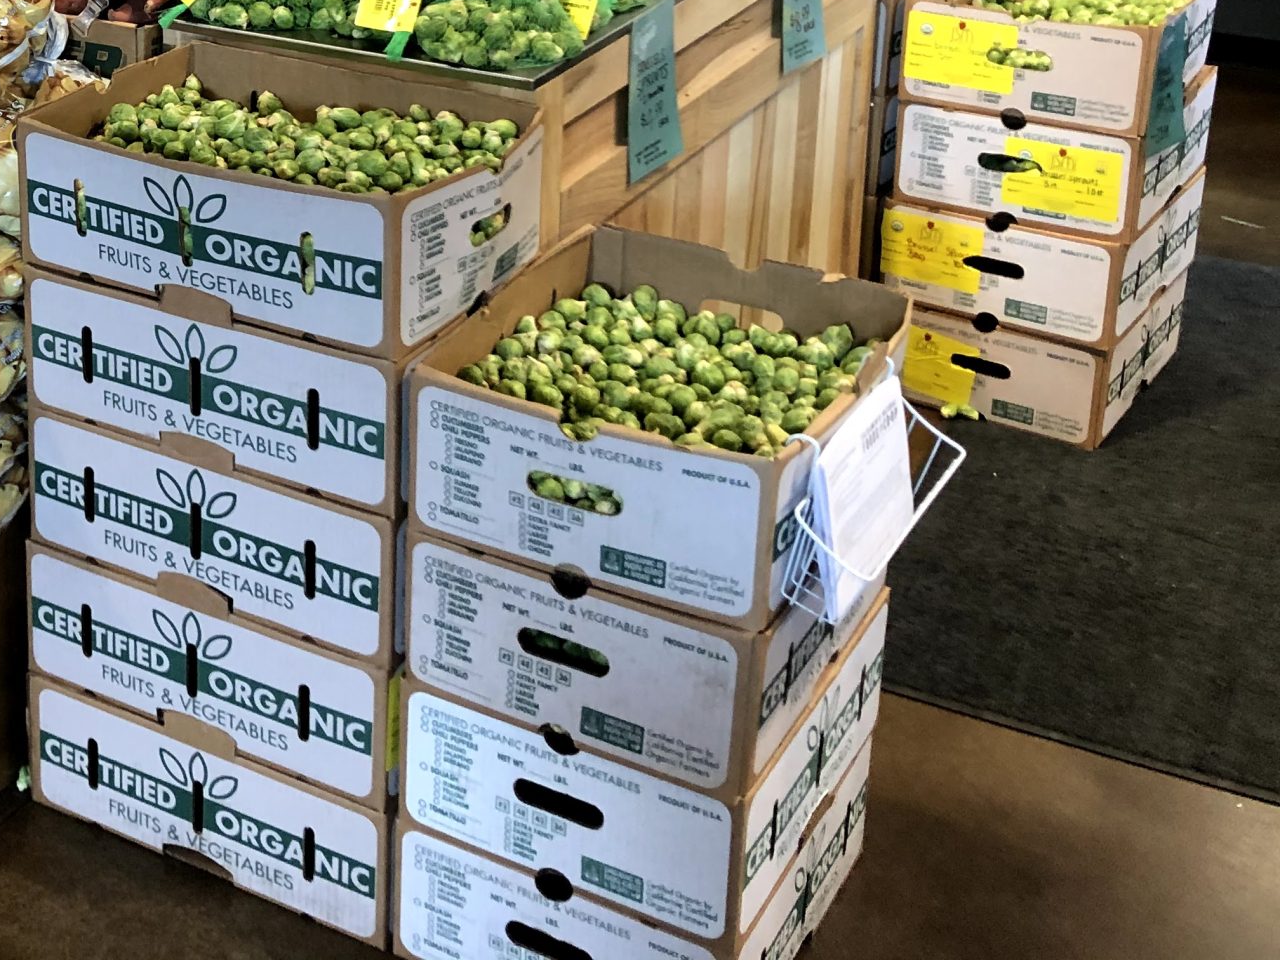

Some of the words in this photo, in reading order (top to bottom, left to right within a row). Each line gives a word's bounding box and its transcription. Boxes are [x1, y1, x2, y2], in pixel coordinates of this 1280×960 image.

[32, 187, 165, 245] CERTIFIED
[205, 234, 377, 295] ORGANIC
[99, 244, 152, 275] FRUITS
[159, 261, 172, 280] &
[176, 265, 294, 310] VEGETABLES
[38, 333, 173, 394] CERTIFIED
[212, 385, 379, 454] ORGANIC
[103, 390, 157, 423] FRUITS
[164, 408, 177, 429] &
[182, 415, 298, 465] VEGETABLES
[430, 399, 479, 423] CERTIFIED
[482, 415, 536, 440] ORGANIC
[538, 432, 574, 452] FRUITS
[577, 443, 586, 455] &
[590, 446, 663, 472] VEGETABLES
[510, 444, 524, 456] NET
[439, 505, 480, 525] TOMATILLO
[681, 468, 715, 482] PRODUCT
[716, 475, 727, 484] OF
[729, 478, 751, 488] U.S.A.
[40, 470, 174, 536] CERTIFIED
[212, 530, 374, 607] ORGANIC
[104, 530, 158, 563] FRUITS
[165, 550, 177, 570] &
[183, 556, 295, 612] VEGETABLES
[425, 555, 473, 580] CERTIFIED
[476, 573, 527, 599] ORGANIC
[530, 591, 565, 612] FRUITS
[569, 604, 577, 615] &
[580, 607, 649, 639] VEGETABLES
[38, 605, 170, 674] CERTIFIED
[207, 670, 368, 751] ORGANIC
[663, 636, 695, 652] PRODUCT
[697, 647, 706, 655] OF
[708, 651, 729, 662] U.S.A.
[102, 664, 155, 700] FRUITS
[162, 688, 174, 707] &
[181, 697, 289, 753] VEGETABLES
[421, 705, 468, 730] CERTIFIED
[471, 724, 522, 750] ORGANIC
[525, 743, 558, 765] FRUITS
[562, 757, 570, 768] &
[573, 762, 641, 795] VEGETABLES
[44, 738, 177, 811] CERTIFIED
[214, 810, 374, 893] ORGANIC
[109, 798, 161, 833] FRUITS
[168, 823, 180, 842] &
[186, 831, 295, 892] VEGETABLES
[464, 864, 513, 891] ORGANIC
[517, 885, 550, 909] FRUITS
[553, 901, 561, 912] &
[564, 906, 630, 940] VEGETABLES
